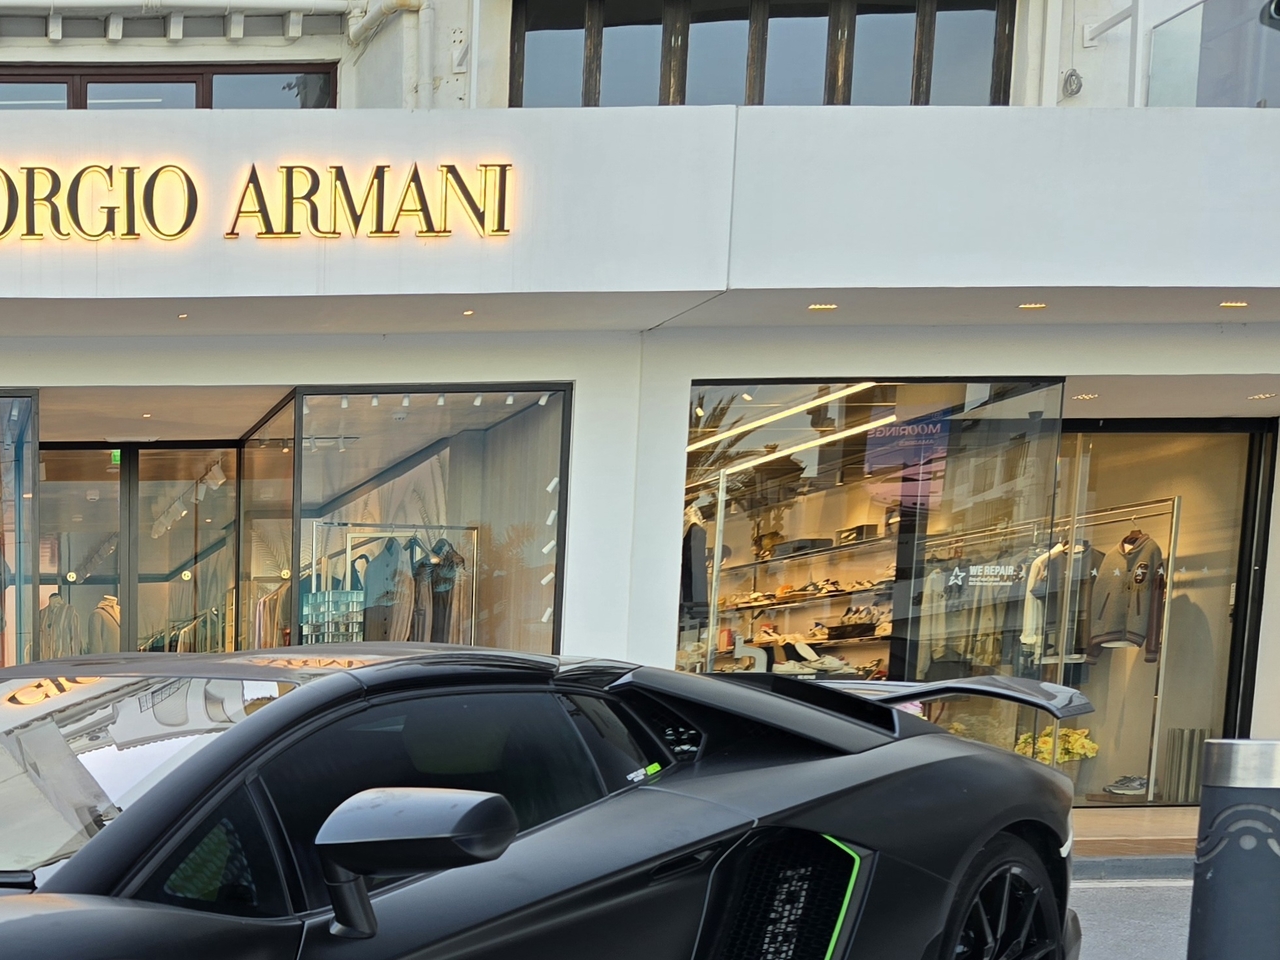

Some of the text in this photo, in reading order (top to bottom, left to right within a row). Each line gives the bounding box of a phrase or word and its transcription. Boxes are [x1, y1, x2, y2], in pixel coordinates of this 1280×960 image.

[224, 162, 513, 238] ARMANI
[969, 565, 1014, 576] WE REPAIR
